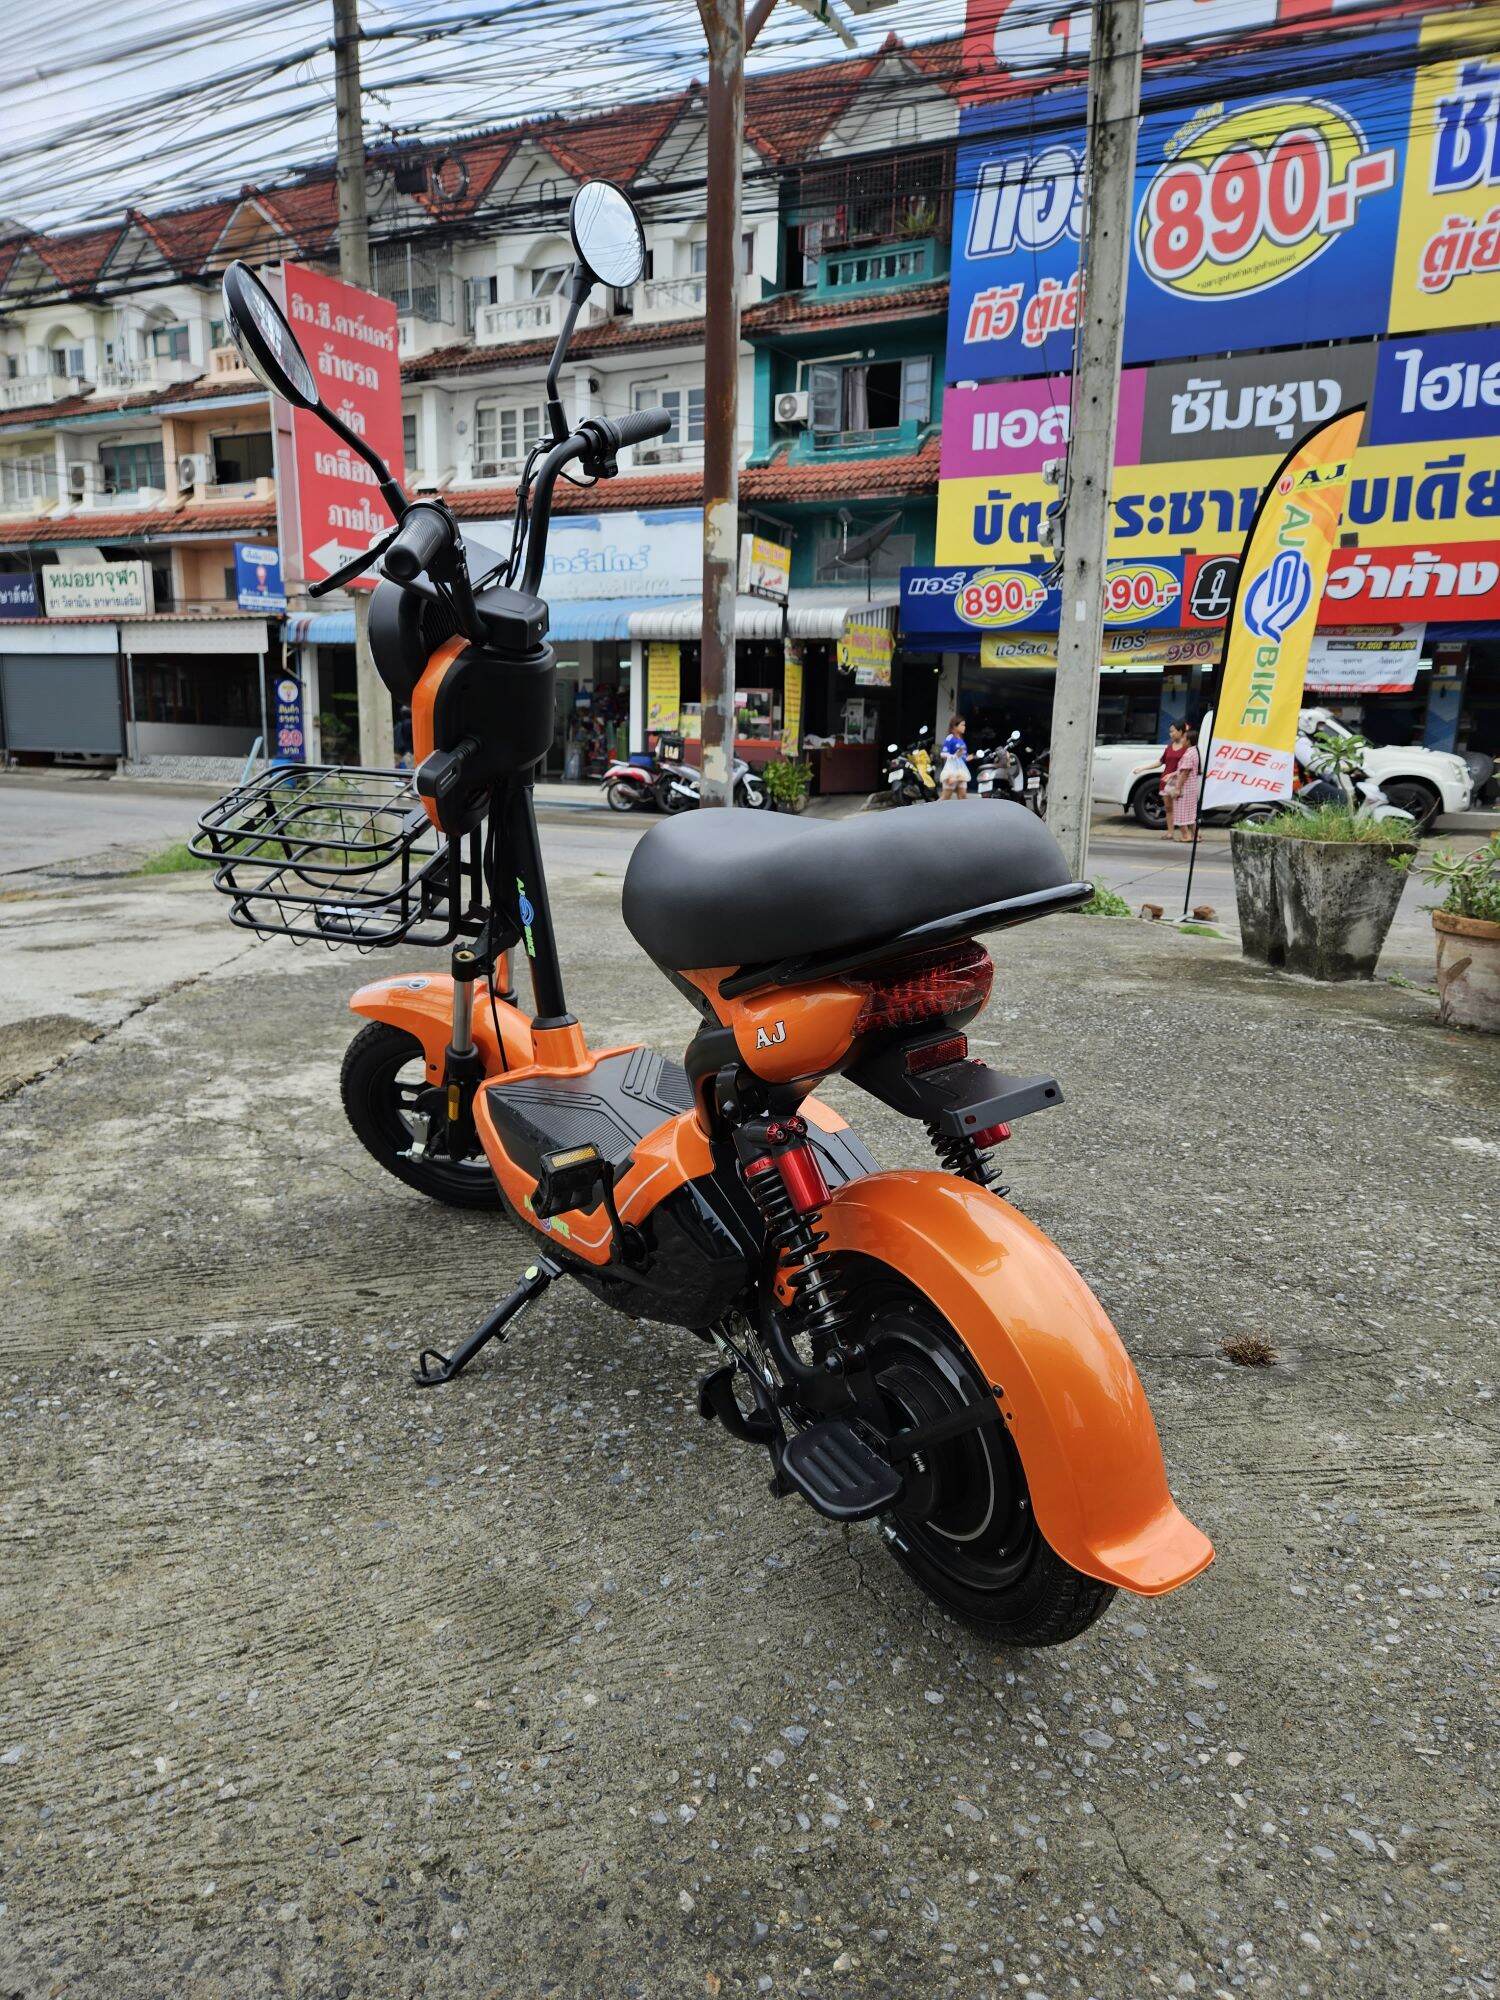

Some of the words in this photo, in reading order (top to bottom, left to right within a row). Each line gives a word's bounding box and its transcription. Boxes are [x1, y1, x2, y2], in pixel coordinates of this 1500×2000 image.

[1146, 129, 1394, 277] 890.-
[964, 283, 1024, 344] ทีวี
[1299, 464, 1348, 485] AJ
[1278, 503, 1311, 547] AJ
[908, 572, 967, 595] แอร์
[963, 578, 1048, 618] 890.-
[1240, 646, 1280, 725] BIKE
[1216, 745, 1272, 766] RIDE
[1206, 768, 1285, 793] FUTURE
[756, 1020, 786, 1049] AJ
